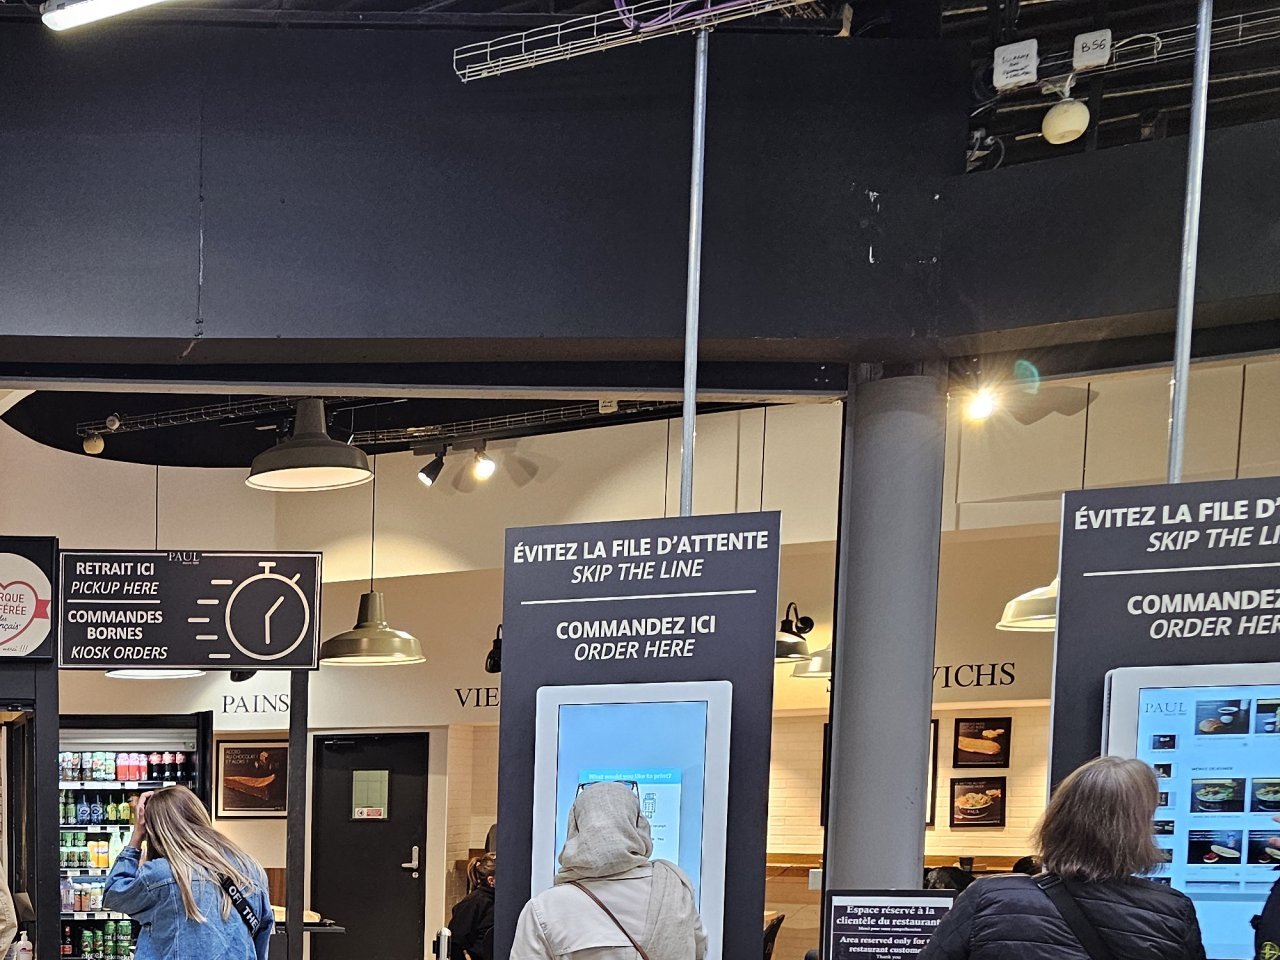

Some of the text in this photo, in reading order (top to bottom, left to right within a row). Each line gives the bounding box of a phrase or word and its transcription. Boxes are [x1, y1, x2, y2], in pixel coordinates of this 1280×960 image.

[1074, 505, 1155, 530] ÉVITEZ
[1162, 503, 1192, 524] LA
[1198, 499, 1249, 523] FILE
[1146, 524, 1280, 552] SKIP THE LI
[169, 551, 200, 562] PAUL
[513, 541, 578, 564] ÉVITEZ
[584, 540, 607, 560] LA
[612, 537, 651, 558] FILE
[76, 562, 155, 577] RETRAIT ICI
[571, 558, 704, 584] SKIP THE LINE
[71, 581, 159, 596] PICKUP HERE
[67, 609, 163, 625] COMMANDES
[86, 626, 144, 641] BORNES
[556, 615, 716, 640] COMMANDEZ ICI
[1149, 614, 1280, 639] ORDER HER
[71, 645, 168, 661] KIOSK ORDERS
[574, 638, 696, 661] ORDER HERE
[222, 693, 290, 714] PAINS
[1144, 701, 1188, 714] PAUL
[846, 905, 879, 916] Espace
[881, 905, 916, 915] réservé
[925, 906, 935, 915] la
[836, 916, 941, 927] clientèle du restaurant
[839, 936, 859, 944] Area
[860, 936, 893, 944] reserved
[893, 937, 911, 946] only
[912, 937, 926, 945] for
[848, 946, 889, 954] restaurant
